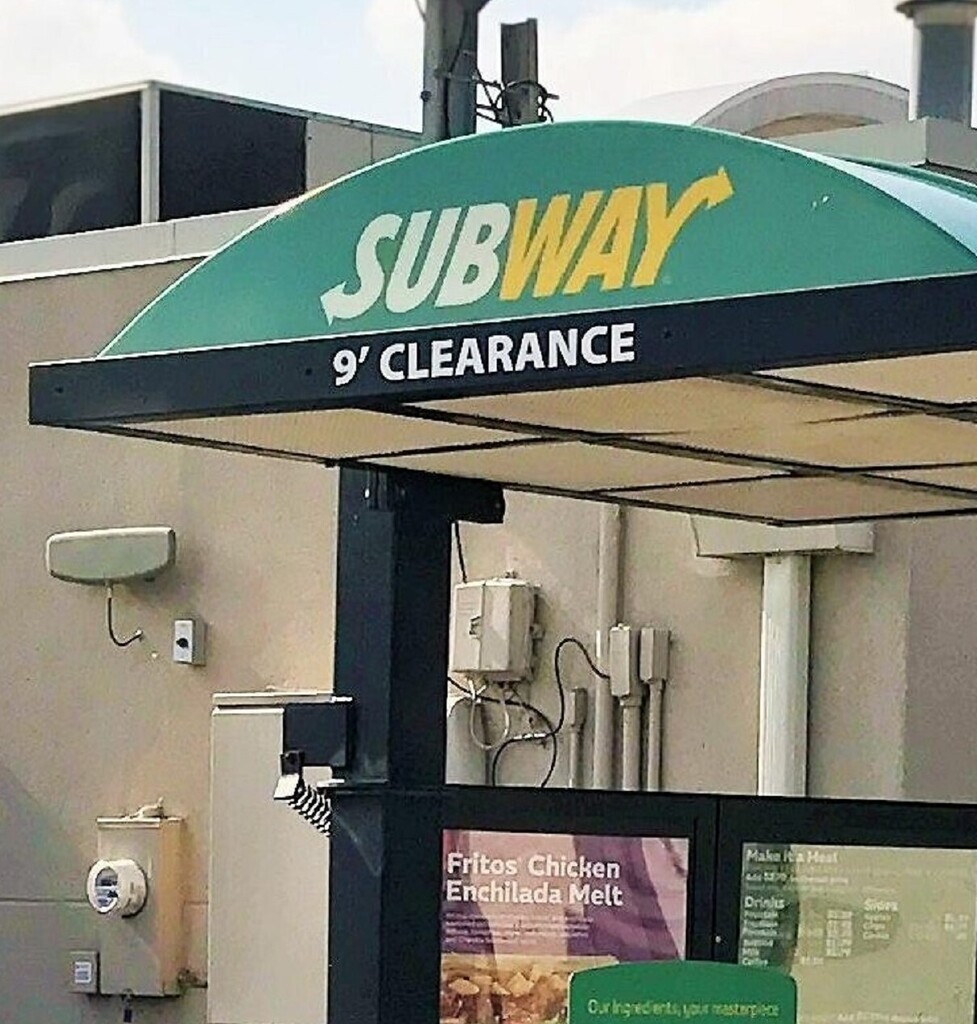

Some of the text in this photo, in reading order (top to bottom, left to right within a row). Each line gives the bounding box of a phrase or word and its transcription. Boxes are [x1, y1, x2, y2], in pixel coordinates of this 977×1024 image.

[320, 166, 734, 326] SUBWAY
[379, 322, 636, 382] CLEARANCE
[527, 855, 621, 879] Chicken
[746, 849, 781, 863] Make
[807, 851, 838, 864] Meal
[446, 879, 624, 907] Enchilada Melt
[744, 896, 786, 910] Drinks
[588, 999, 610, 1014] Our
[683, 1002, 709, 1018] your
[712, 1003, 780, 1018] masterpiece
